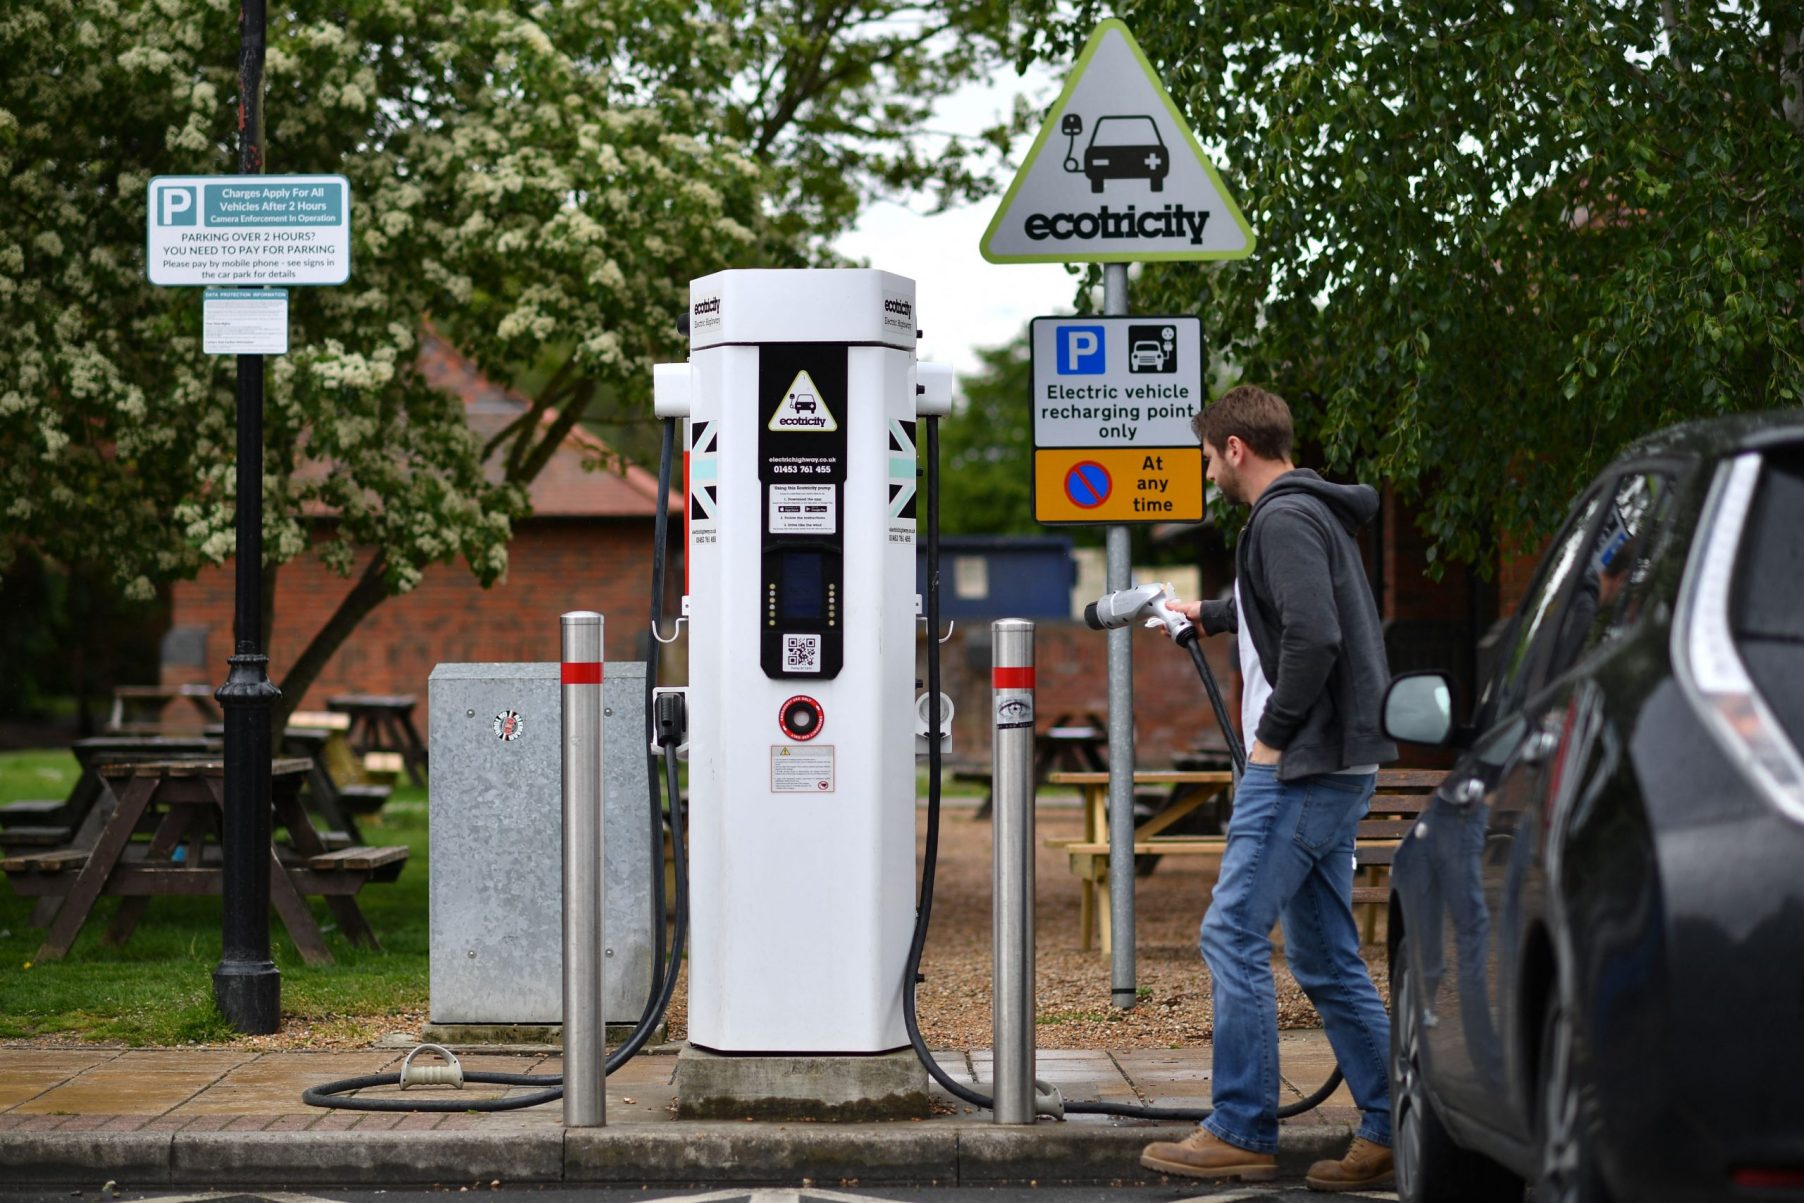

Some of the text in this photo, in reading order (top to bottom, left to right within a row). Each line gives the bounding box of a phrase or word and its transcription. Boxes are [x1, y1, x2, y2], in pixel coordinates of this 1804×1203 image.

[222, 188, 323, 199] Charges Apply For All
[164, 188, 191, 224] P
[220, 201, 326, 211] Vehicles After 2 Hours
[211, 215, 238, 223] Camera
[241, 214, 287, 223] Enforcement
[299, 214, 336, 223] Operation
[1025, 204, 1210, 244] ecotricity
[182, 232, 316, 242] PARKING OVER 2 HOURS?
[163, 245, 335, 255] YOU NEED TO PAY FOR PARKING
[163, 260, 190, 268] Please
[210, 260, 219, 269] by
[253, 259, 279, 268] phone
[304, 259, 324, 268] signs
[233, 270, 252, 279] park
[254, 270, 266, 278] for
[269, 270, 296, 278] details
[695, 296, 720, 315] ecotricity
[885, 299, 911, 320] ecotricity
[1069, 332, 1098, 370] P
[1048, 384, 1188, 399] Electric vehicle
[1042, 404, 1194, 421] recharging point
[780, 417, 826, 427] ecotricity
[1100, 424, 1137, 440] only
[1143, 457, 1163, 470] At
[1137, 479, 1168, 492] any
[1134, 498, 1172, 511] time
